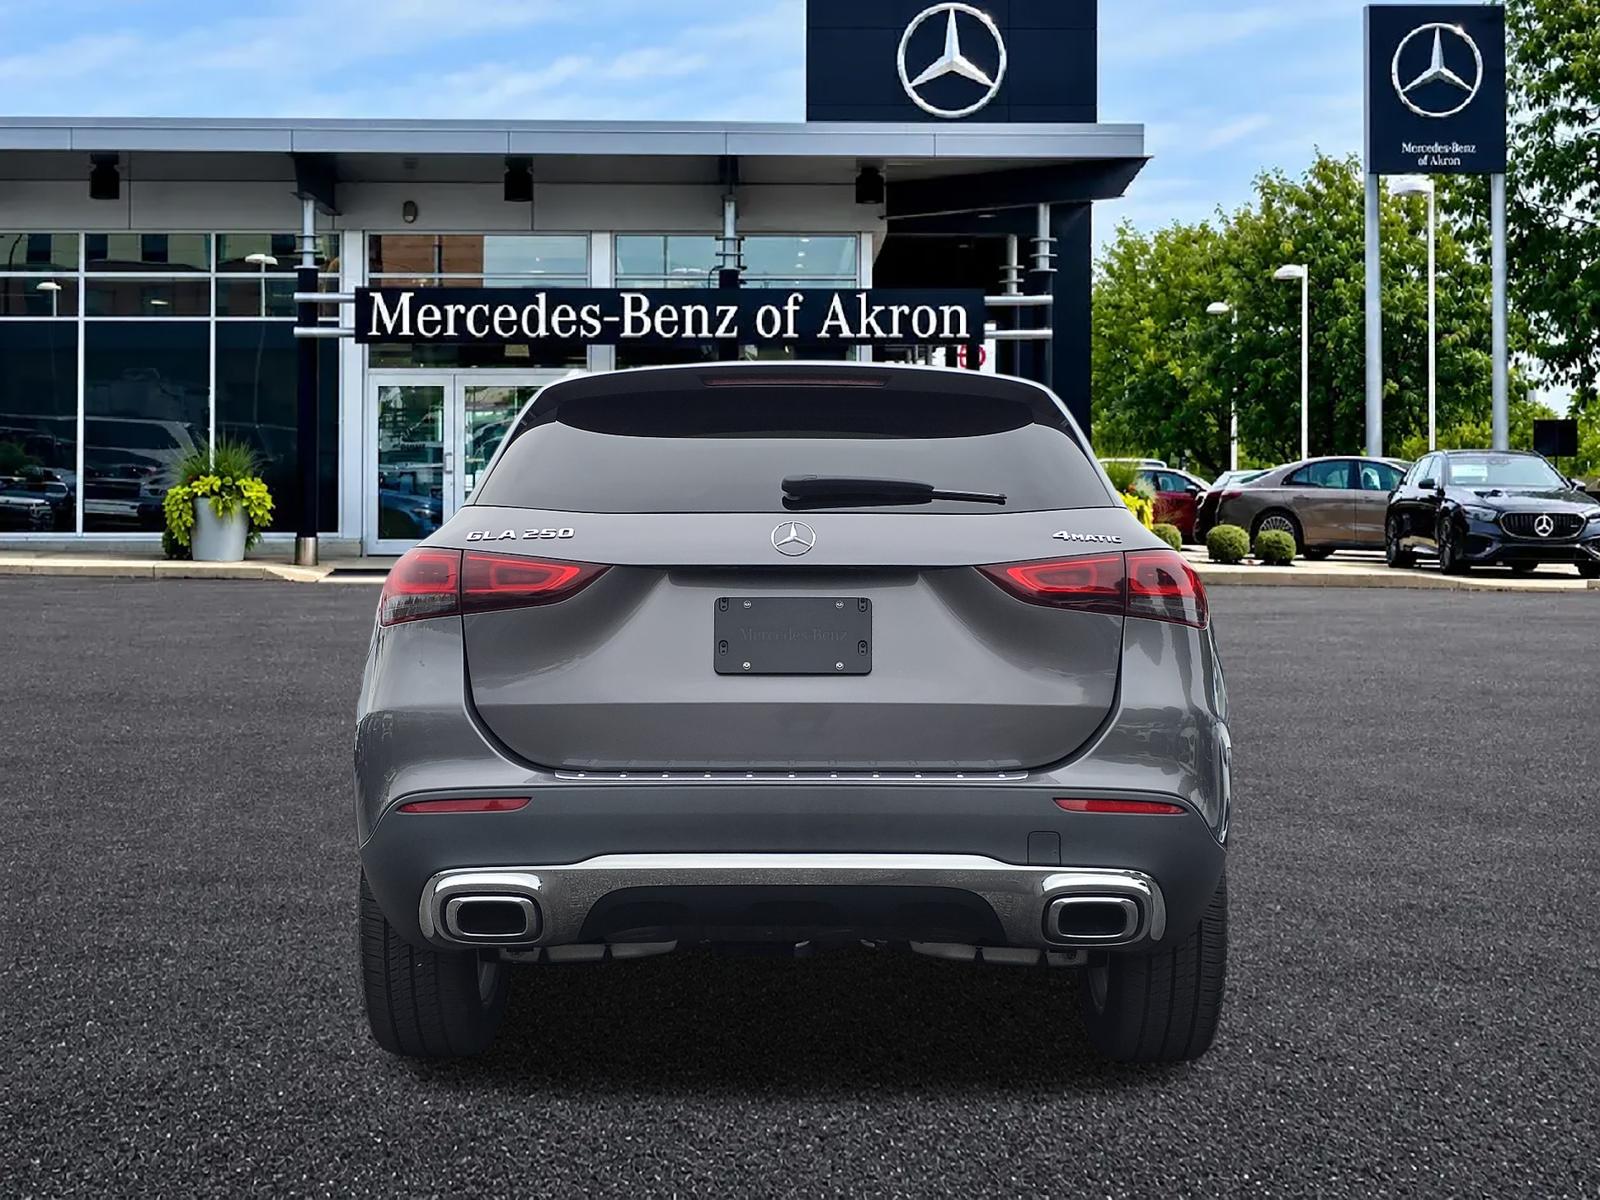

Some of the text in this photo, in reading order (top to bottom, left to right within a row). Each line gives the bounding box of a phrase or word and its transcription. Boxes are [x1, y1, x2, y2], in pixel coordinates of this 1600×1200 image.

[1401, 142, 1477, 153] Mercedes-Benz
[1417, 155, 1461, 166] of Akron
[368, 292, 971, 339] Mercedes-Benz of Akron
[466, 527, 576, 541] GLA 250
[1052, 530, 1122, 544] 4MATIC
